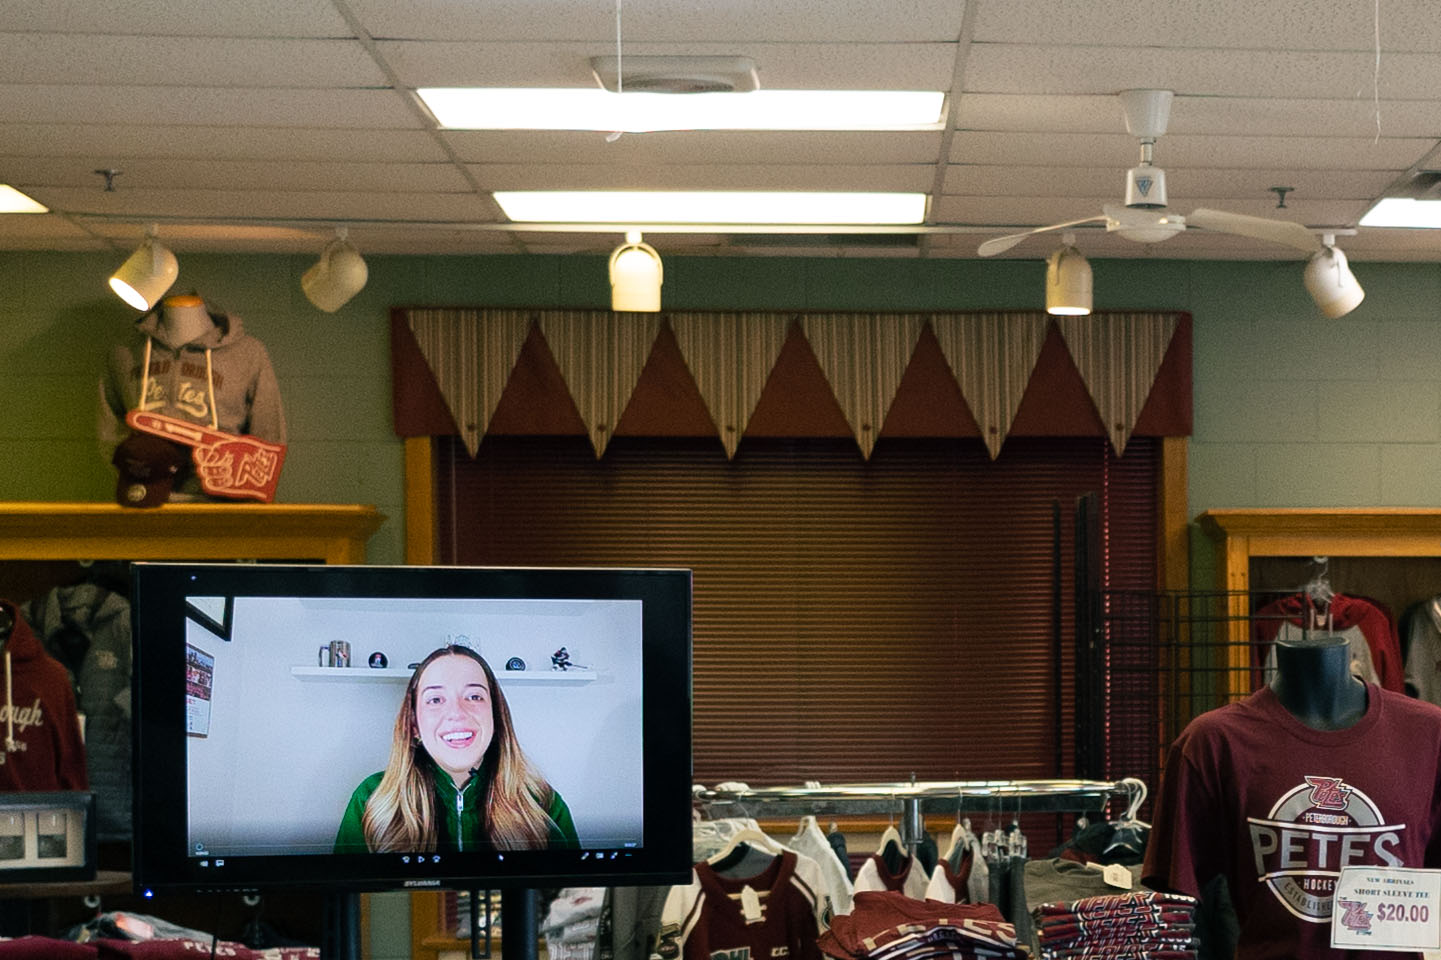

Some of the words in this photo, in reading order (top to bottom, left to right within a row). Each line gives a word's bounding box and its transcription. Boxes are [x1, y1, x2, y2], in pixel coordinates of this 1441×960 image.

[1304, 776, 1352, 810] Petes
[1250, 822, 1404, 877] PETES
[1354, 888, 1380, 896] SHORT
[1377, 902, 1430, 923] $20.00
